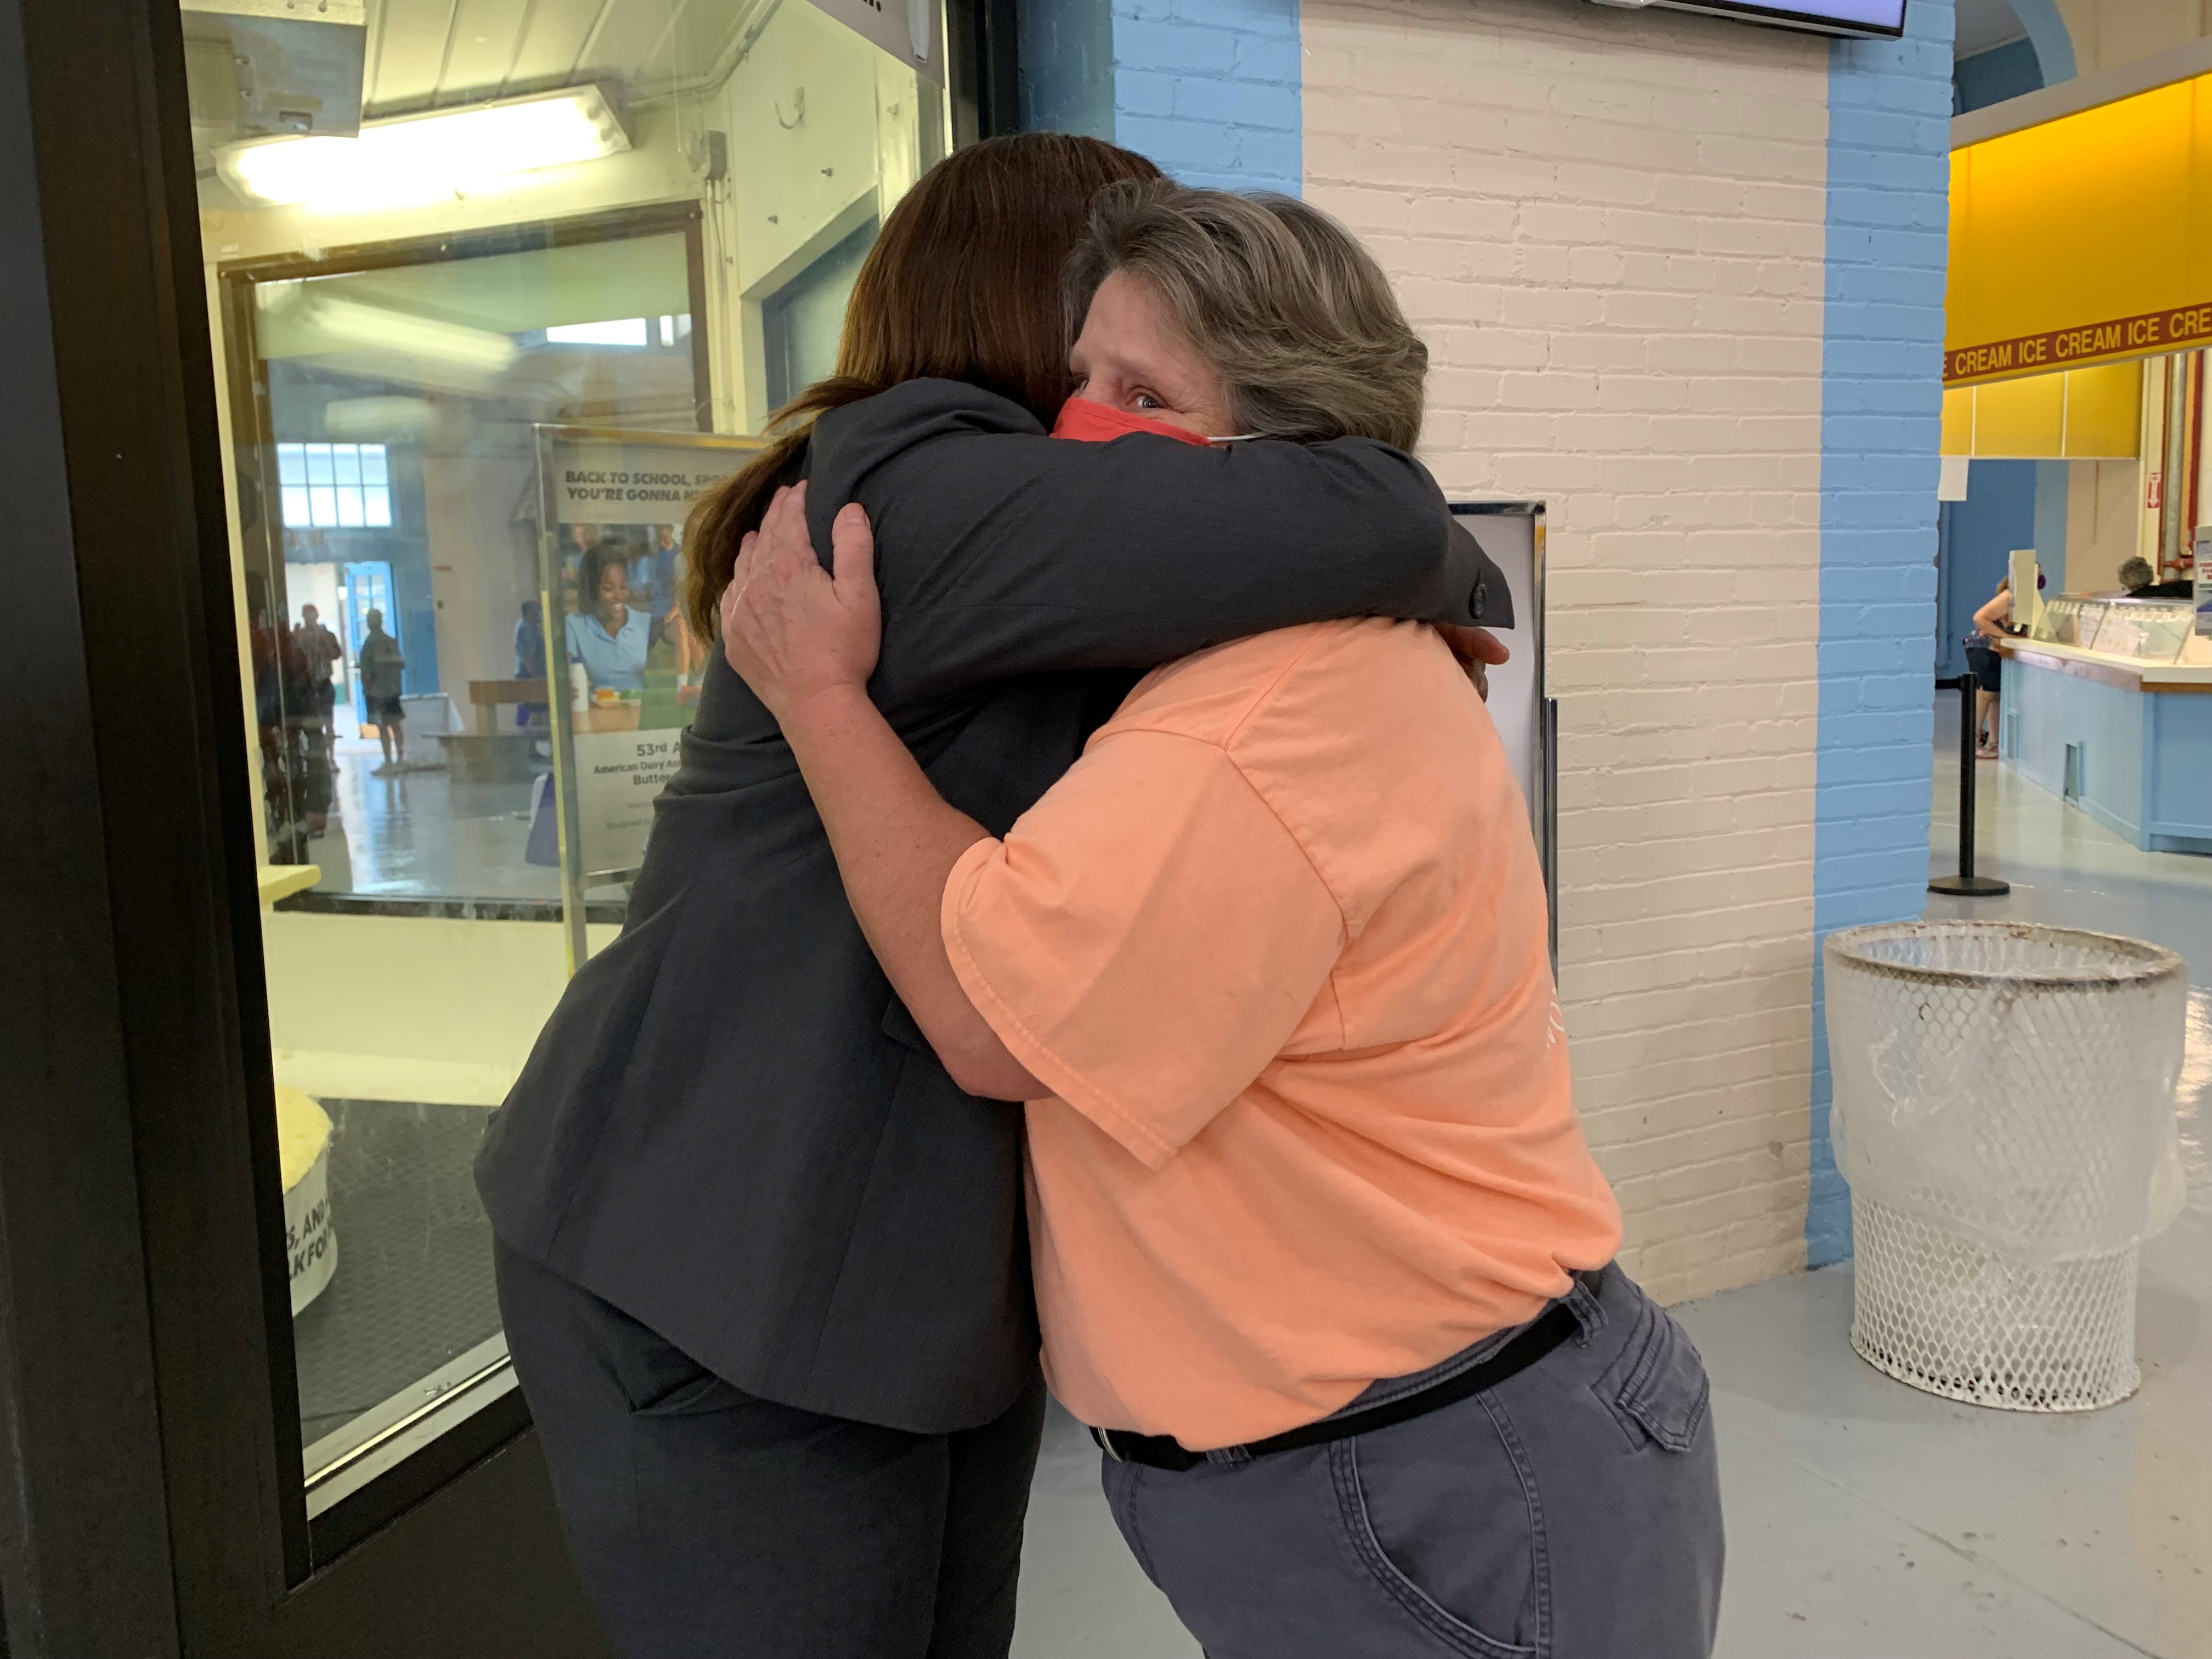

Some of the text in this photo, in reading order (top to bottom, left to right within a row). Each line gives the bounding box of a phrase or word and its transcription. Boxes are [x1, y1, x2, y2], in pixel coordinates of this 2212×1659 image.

[1955, 344, 2012, 376] CREAM
[2018, 338, 2047, 364] ICE
[2055, 324, 2121, 358] CREAM
[2128, 318, 2160, 345] ICE
[2169, 308, 2212, 338] CRE
[566, 470, 606, 483] BACK
[610, 472, 629, 484] TO
[633, 473, 691, 487] SCHOOL,
[567, 487, 623, 500] YOU'RE
[626, 488, 680, 501] GONNA
[637, 742, 667, 756] 53rd
[594, 763, 638, 774] American
[640, 760, 664, 771] Dairy
[303, 1199, 325, 1239] AND
